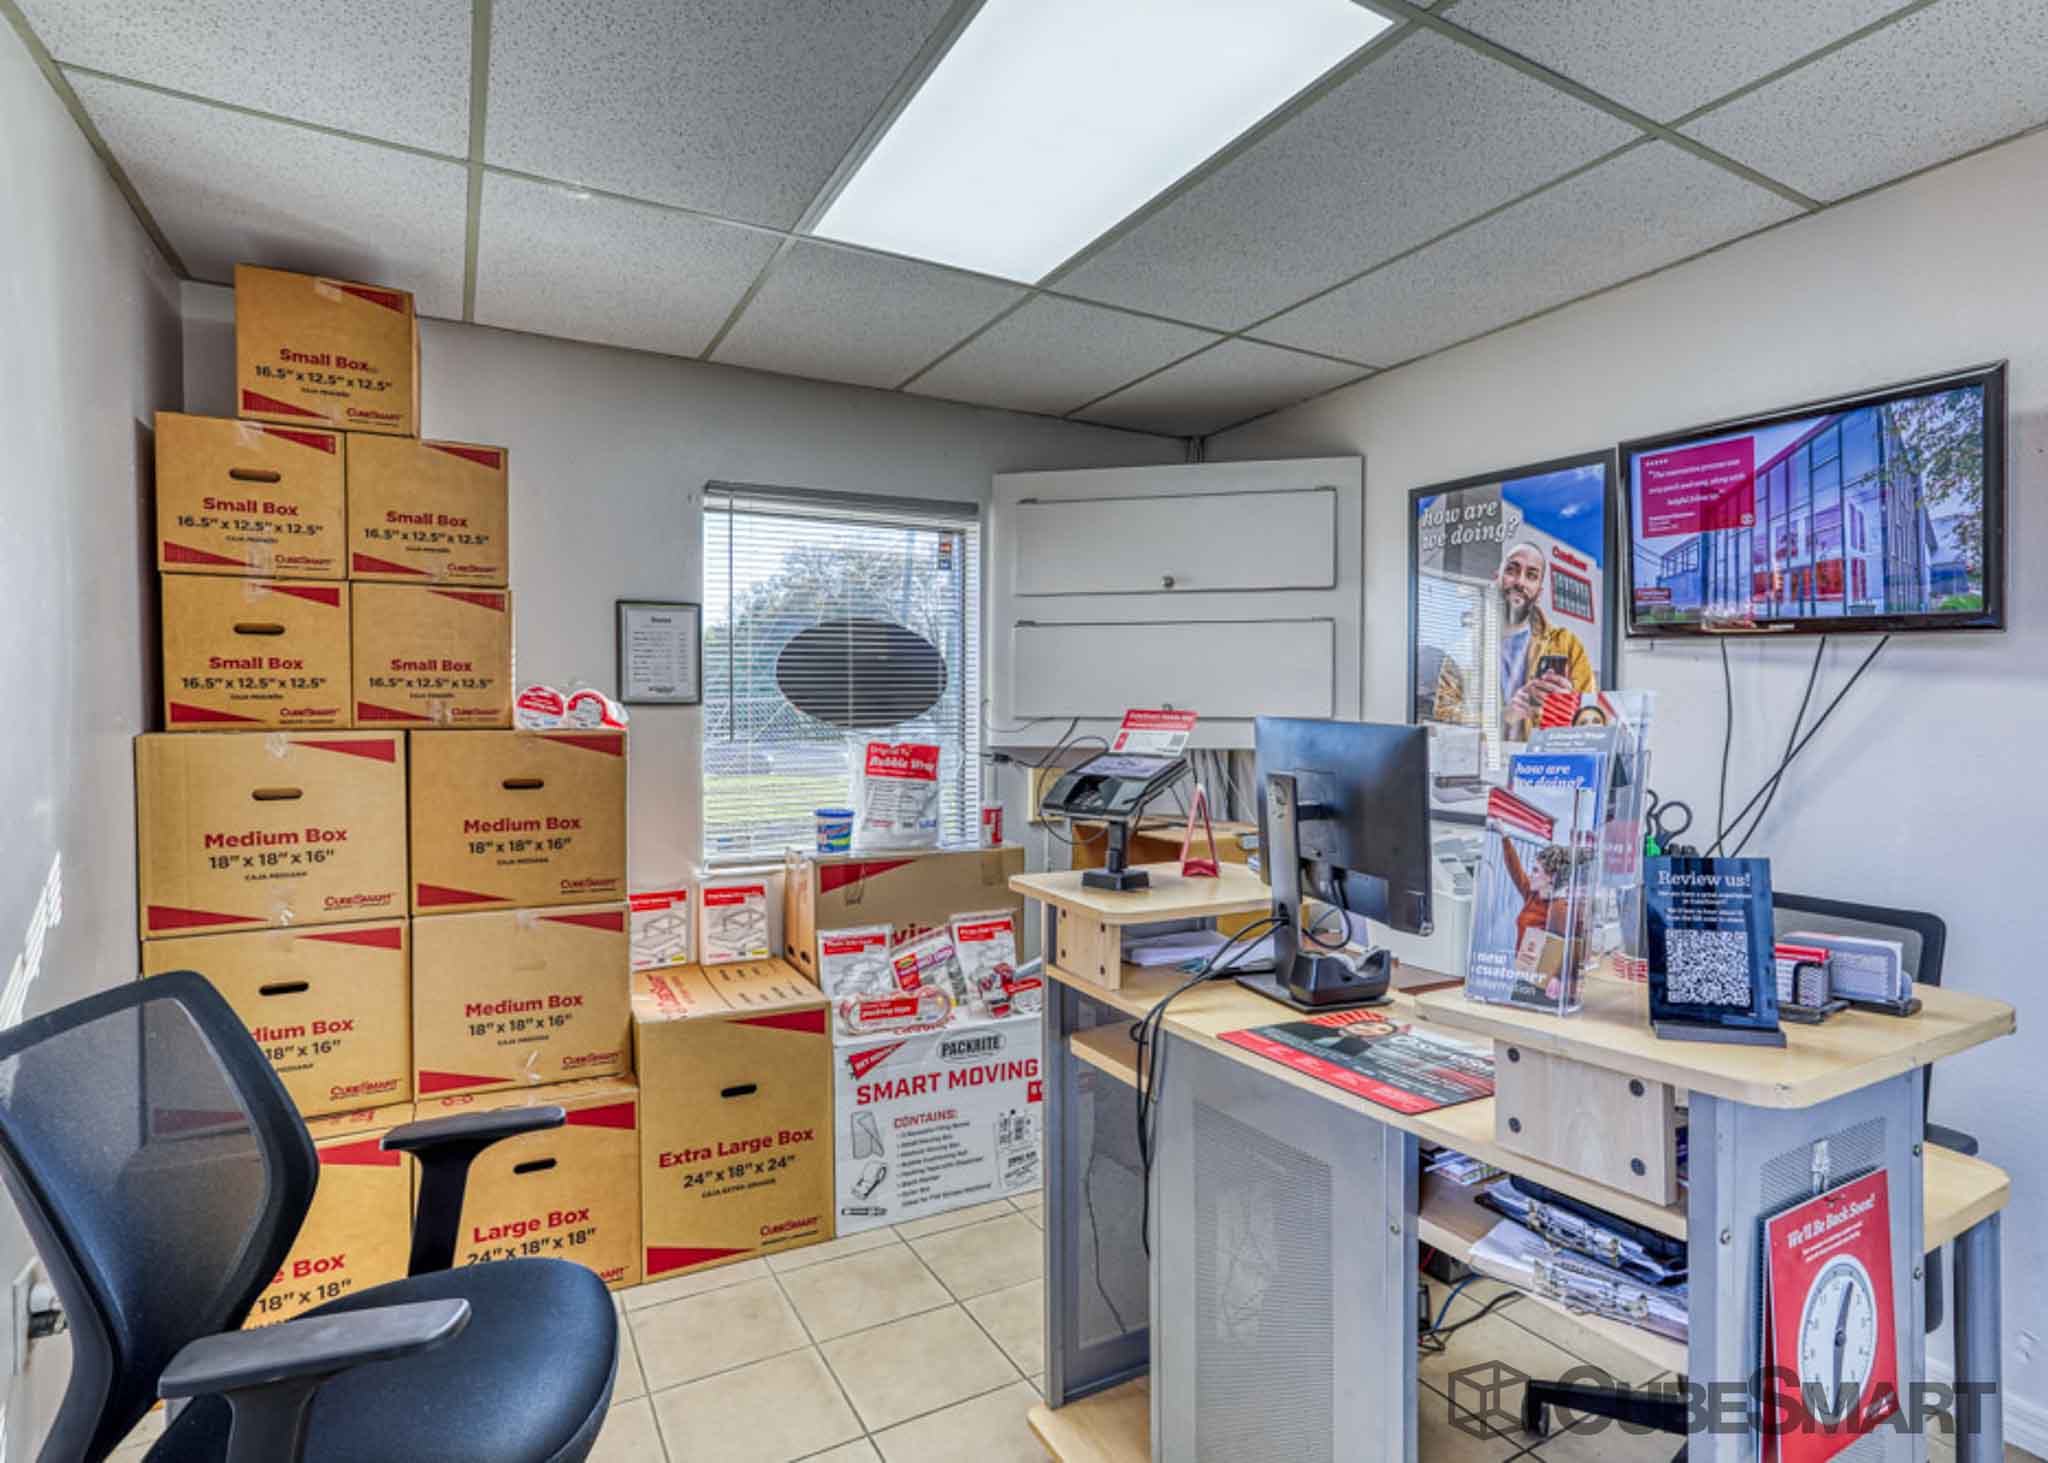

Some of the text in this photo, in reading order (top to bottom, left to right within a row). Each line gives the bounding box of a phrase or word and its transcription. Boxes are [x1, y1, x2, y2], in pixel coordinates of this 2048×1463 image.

[279, 348, 369, 372] Small Box
[347, 379, 354, 387] x
[203, 497, 299, 516] Small Box
[1423, 502, 1497, 527] how are
[221, 521, 230, 529] x
[275, 525, 283, 533] x
[386, 510, 469, 528] Small Box
[447, 535, 454, 543] x
[1423, 515, 1519, 547] we doing?
[208, 656, 304, 670] Small Box
[390, 659, 473, 672] Small Box
[225, 680, 234, 688] x
[279, 680, 287, 688] x
[405, 680, 413, 688] x
[451, 680, 459, 688] x
[1516, 763, 1571, 776] how are
[463, 816, 582, 834] Medium Box
[205, 828, 348, 848] Medium Box
[468, 837, 572, 855] 18" x 18" x 16"
[209, 849, 335, 869] 18" x 18" x 16"
[1658, 870, 1751, 887] Review us!
[1478, 952, 1507, 964] new
[465, 994, 584, 1018] Medium Box
[251, 1019, 354, 1042] dium Box
[468, 1013, 573, 1037] 18" x 18" x 16"
[297, 1046, 308, 1057] x
[312, 1039, 341, 1054] 16"
[941, 1036, 1000, 1058] PACKRITE
[857, 1058, 1039, 1105] SMART MOVING
[658, 1128, 815, 1168] Extra Large Box
[683, 1155, 795, 1188] 24" x 18" x 24"
[473, 1208, 590, 1244] Large Box
[467, 1227, 597, 1266] 24" x 18" x 18"
[293, 1254, 346, 1279] Box
[259, 1278, 352, 1312] 18" x 18"
